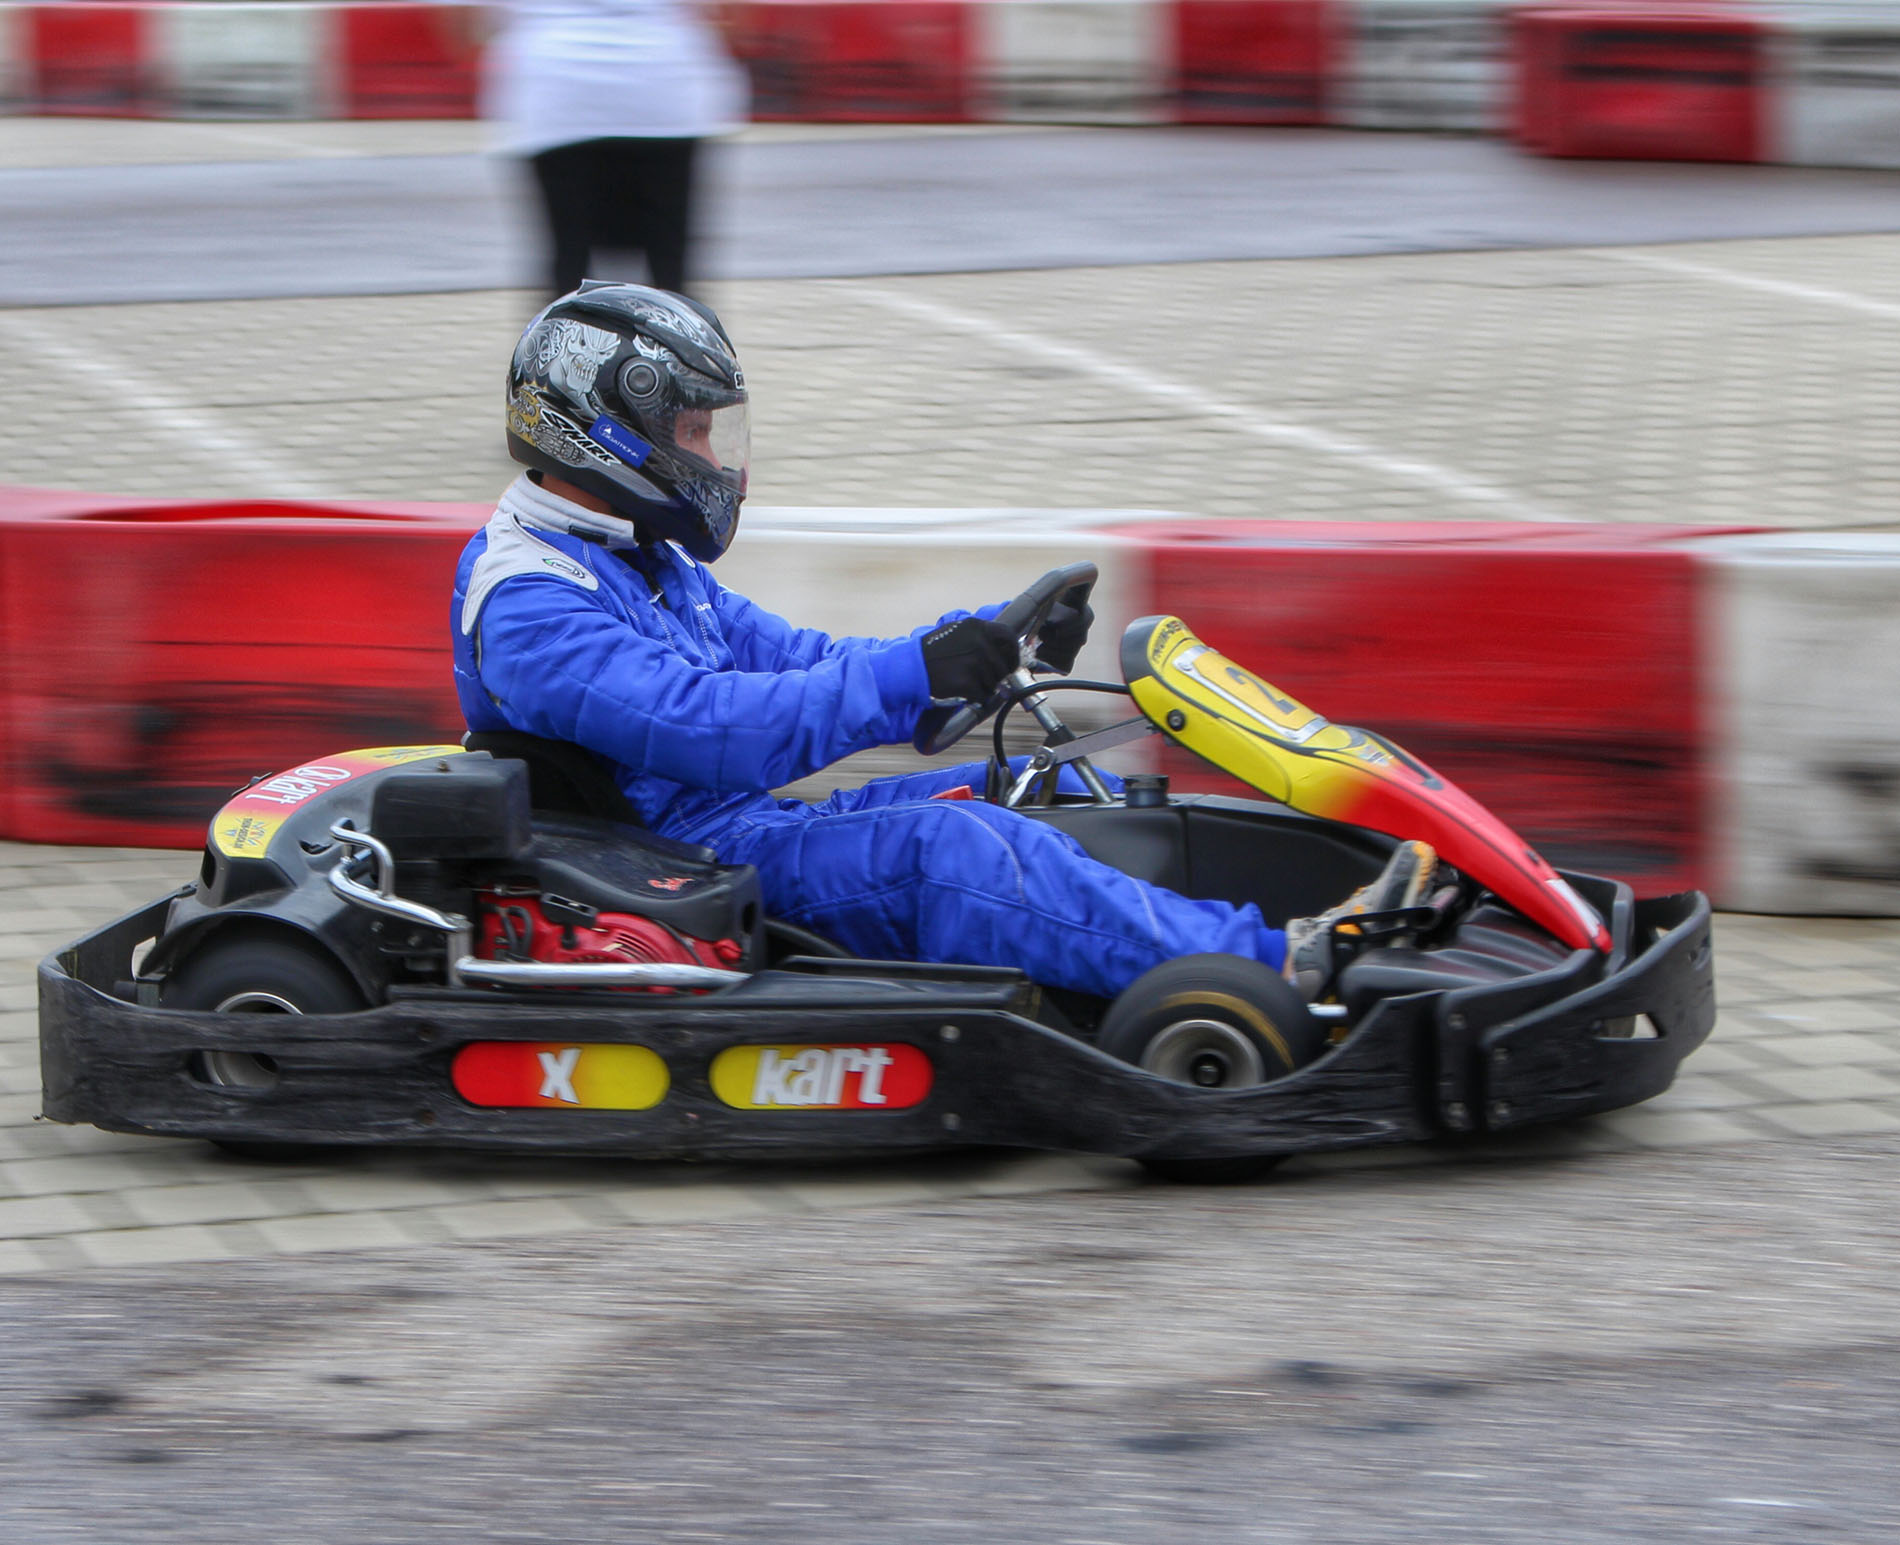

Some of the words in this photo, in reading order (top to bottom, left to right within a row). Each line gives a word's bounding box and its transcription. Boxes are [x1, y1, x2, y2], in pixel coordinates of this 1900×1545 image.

[540, 408, 622, 467] SHARK
[1225, 666, 1299, 715] 2
[752, 1047, 894, 1105] kart
